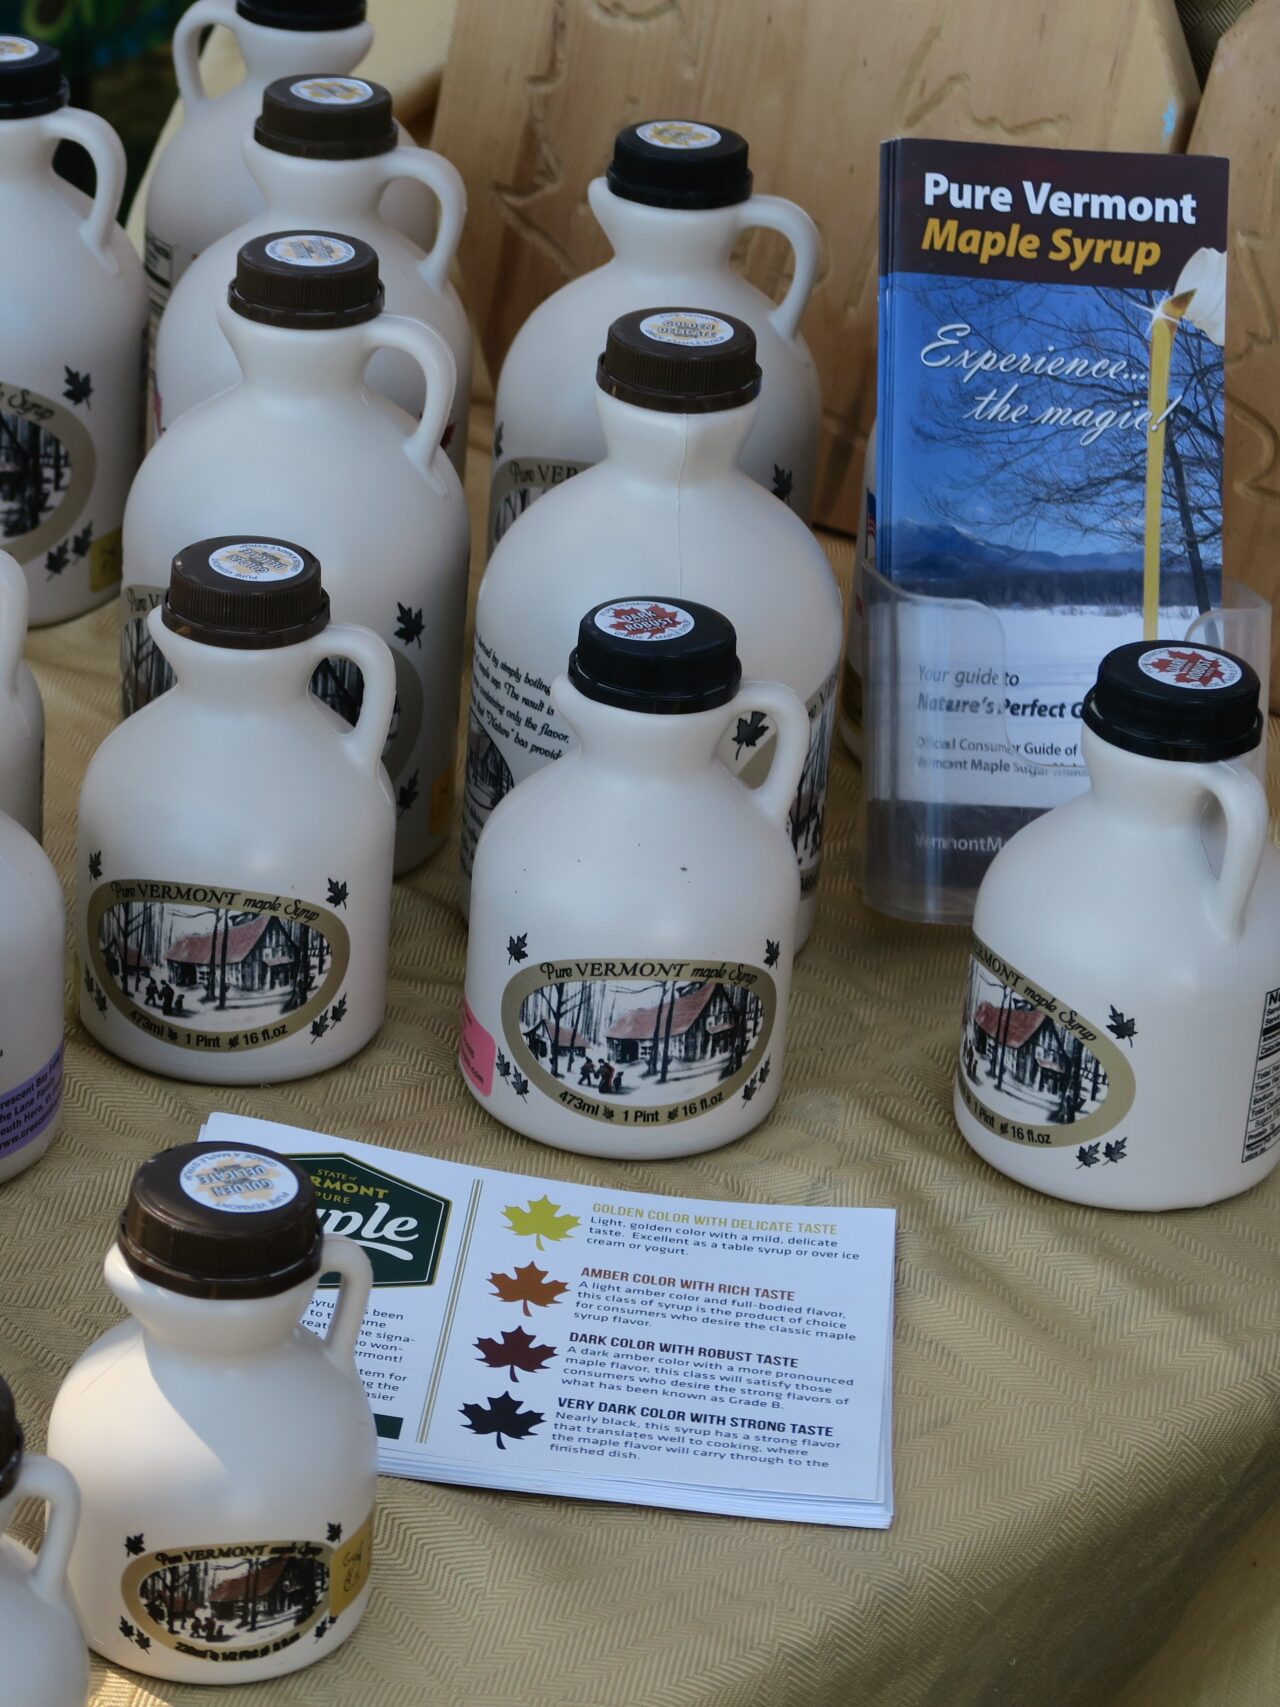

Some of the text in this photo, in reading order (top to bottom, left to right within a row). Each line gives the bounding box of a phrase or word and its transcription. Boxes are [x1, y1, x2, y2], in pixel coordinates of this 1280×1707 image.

[924, 172, 1197, 224] Pure Vermont
[922, 218, 1162, 274] Maple Syrup
[920, 323, 1146, 386] Experience...
[8, 389, 56, 422] Syrup
[964, 384, 1183, 447] the magic!
[621, 609, 657, 621] DARK
[624, 617, 675, 631] ROBUST
[500, 658, 551, 696] simply boiling
[954, 668, 1020, 688] guide to
[1167, 659, 1186, 672] DARK
[1188, 659, 1213, 680] ROBUST
[503, 682, 520, 700] The
[546, 704, 555, 716] is
[998, 697, 1066, 719] Perfect
[1024, 743, 1061, 756] Guide
[1064, 744, 1078, 756] of
[970, 760, 1011, 775] Maple
[110, 880, 320, 923] Pure VERMONT maple Syrup
[540, 961, 758, 986] Pure VERMONT maple Syrup
[1024, 985, 1096, 1041] maple Syrup
[129, 1008, 288, 1048] 473ml 1 Pint 16 fl.oz
[13, 1097, 35, 1116] Lane
[558, 1091, 725, 1123] 473ml 1 Pint 16 fl.oz
[980, 1105, 1052, 1145] Pint 16 fl.oz
[199, 1164, 266, 1184] DELICATE
[317, 1168, 348, 1180] STATE
[211, 1178, 273, 1197] GOLDEN
[592, 1202, 836, 1235] GOLDEN COLOR WITH DELICATE TASTE
[585, 1238, 625, 1248] cream
[628, 1242, 641, 1250] or
[629, 1220, 672, 1232] golden
[674, 1225, 706, 1235] color
[708, 1228, 738, 1238] with
[787, 1234, 837, 1248] delicate
[631, 1230, 689, 1244] Excellent
[692, 1237, 707, 1245] as
[720, 1238, 754, 1250] table
[757, 1244, 792, 1256] syrup
[794, 1247, 808, 1255] or
[810, 1249, 838, 1258] over
[841, 1252, 859, 1260] ice
[580, 1266, 794, 1301] AMBER COLOR WITH RICH TASTE
[372, 1309, 404, 1321] been
[371, 1342, 403, 1352] won-
[375, 1329, 416, 1345] signa-
[568, 1333, 798, 1368] DARK COLOR WITH ROBUST TASTE
[556, 1398, 833, 1437] VERY DARK COLOR WITH STRONG TASTE
[183, 1544, 269, 1562] VERMONT
